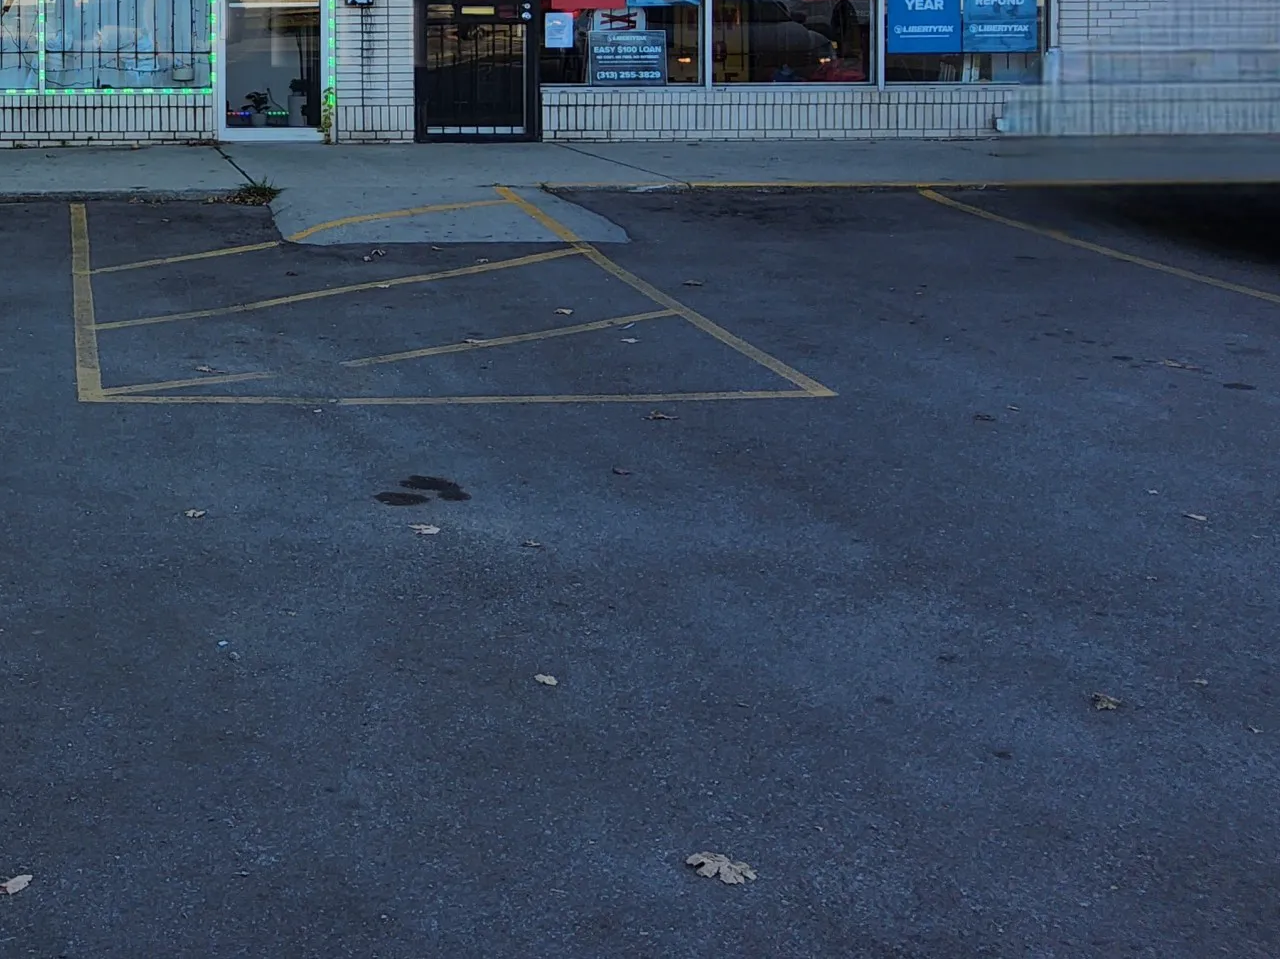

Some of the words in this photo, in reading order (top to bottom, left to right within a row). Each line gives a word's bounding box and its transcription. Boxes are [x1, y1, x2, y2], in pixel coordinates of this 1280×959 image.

[905, 0, 944, 10] YEAR
[593, 46, 616, 54] EASY
[596, 71, 618, 80] (313)
[619, 71, 661, 79] 255-3829
